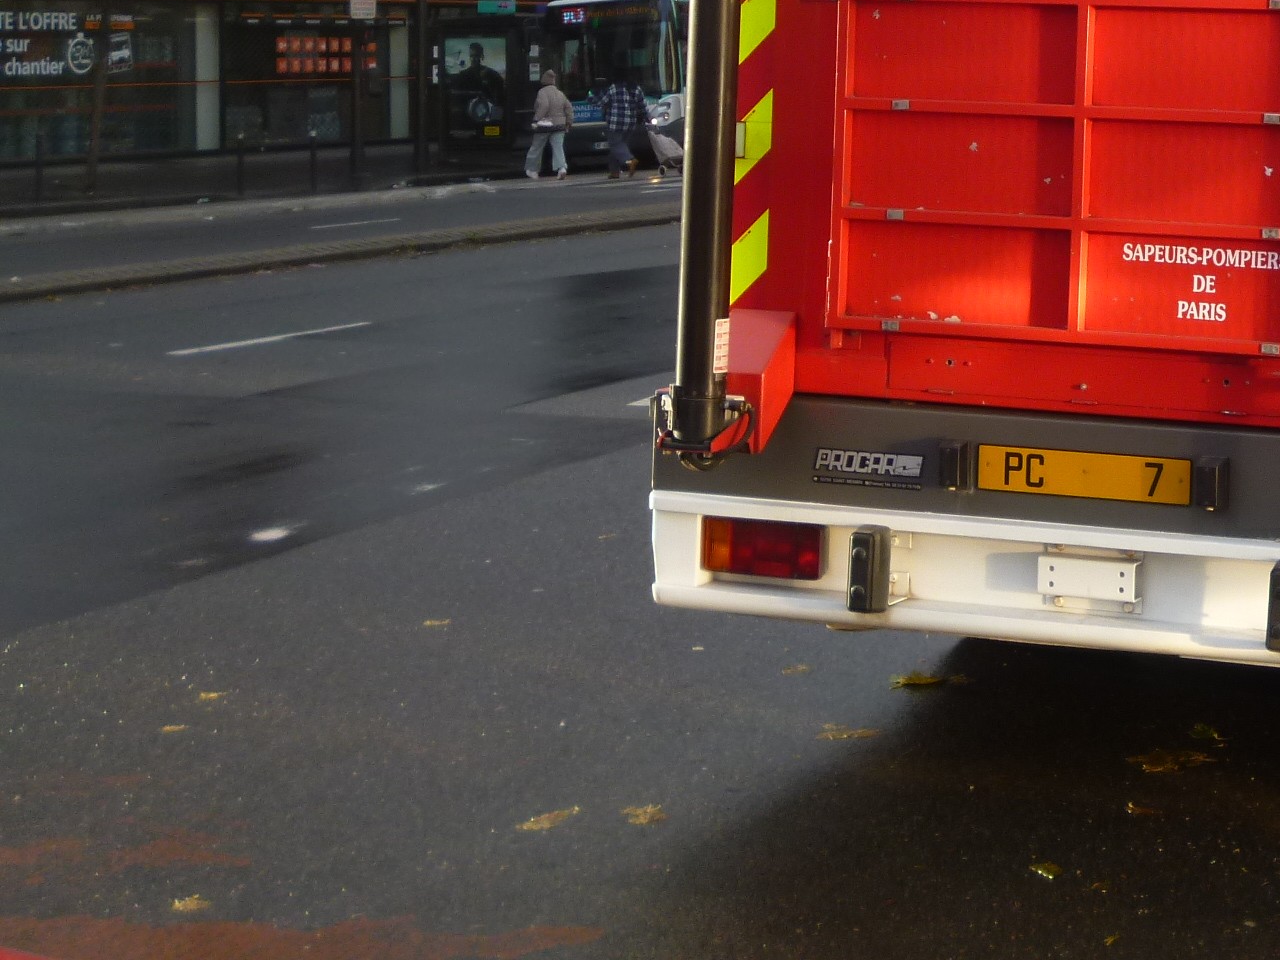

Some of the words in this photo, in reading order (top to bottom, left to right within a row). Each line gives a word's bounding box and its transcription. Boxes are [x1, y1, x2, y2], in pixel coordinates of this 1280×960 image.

[18, 11, 77, 30] L'OFFRE
[6, 38, 31, 52] sur
[5, 55, 65, 75] chantier
[1192, 274, 1216, 293] DE
[1177, 300, 1227, 322] PARIS
[815, 448, 898, 476] PROCAR
[1004, 451, 1045, 488] PC
[1144, 462, 1164, 497] 7
